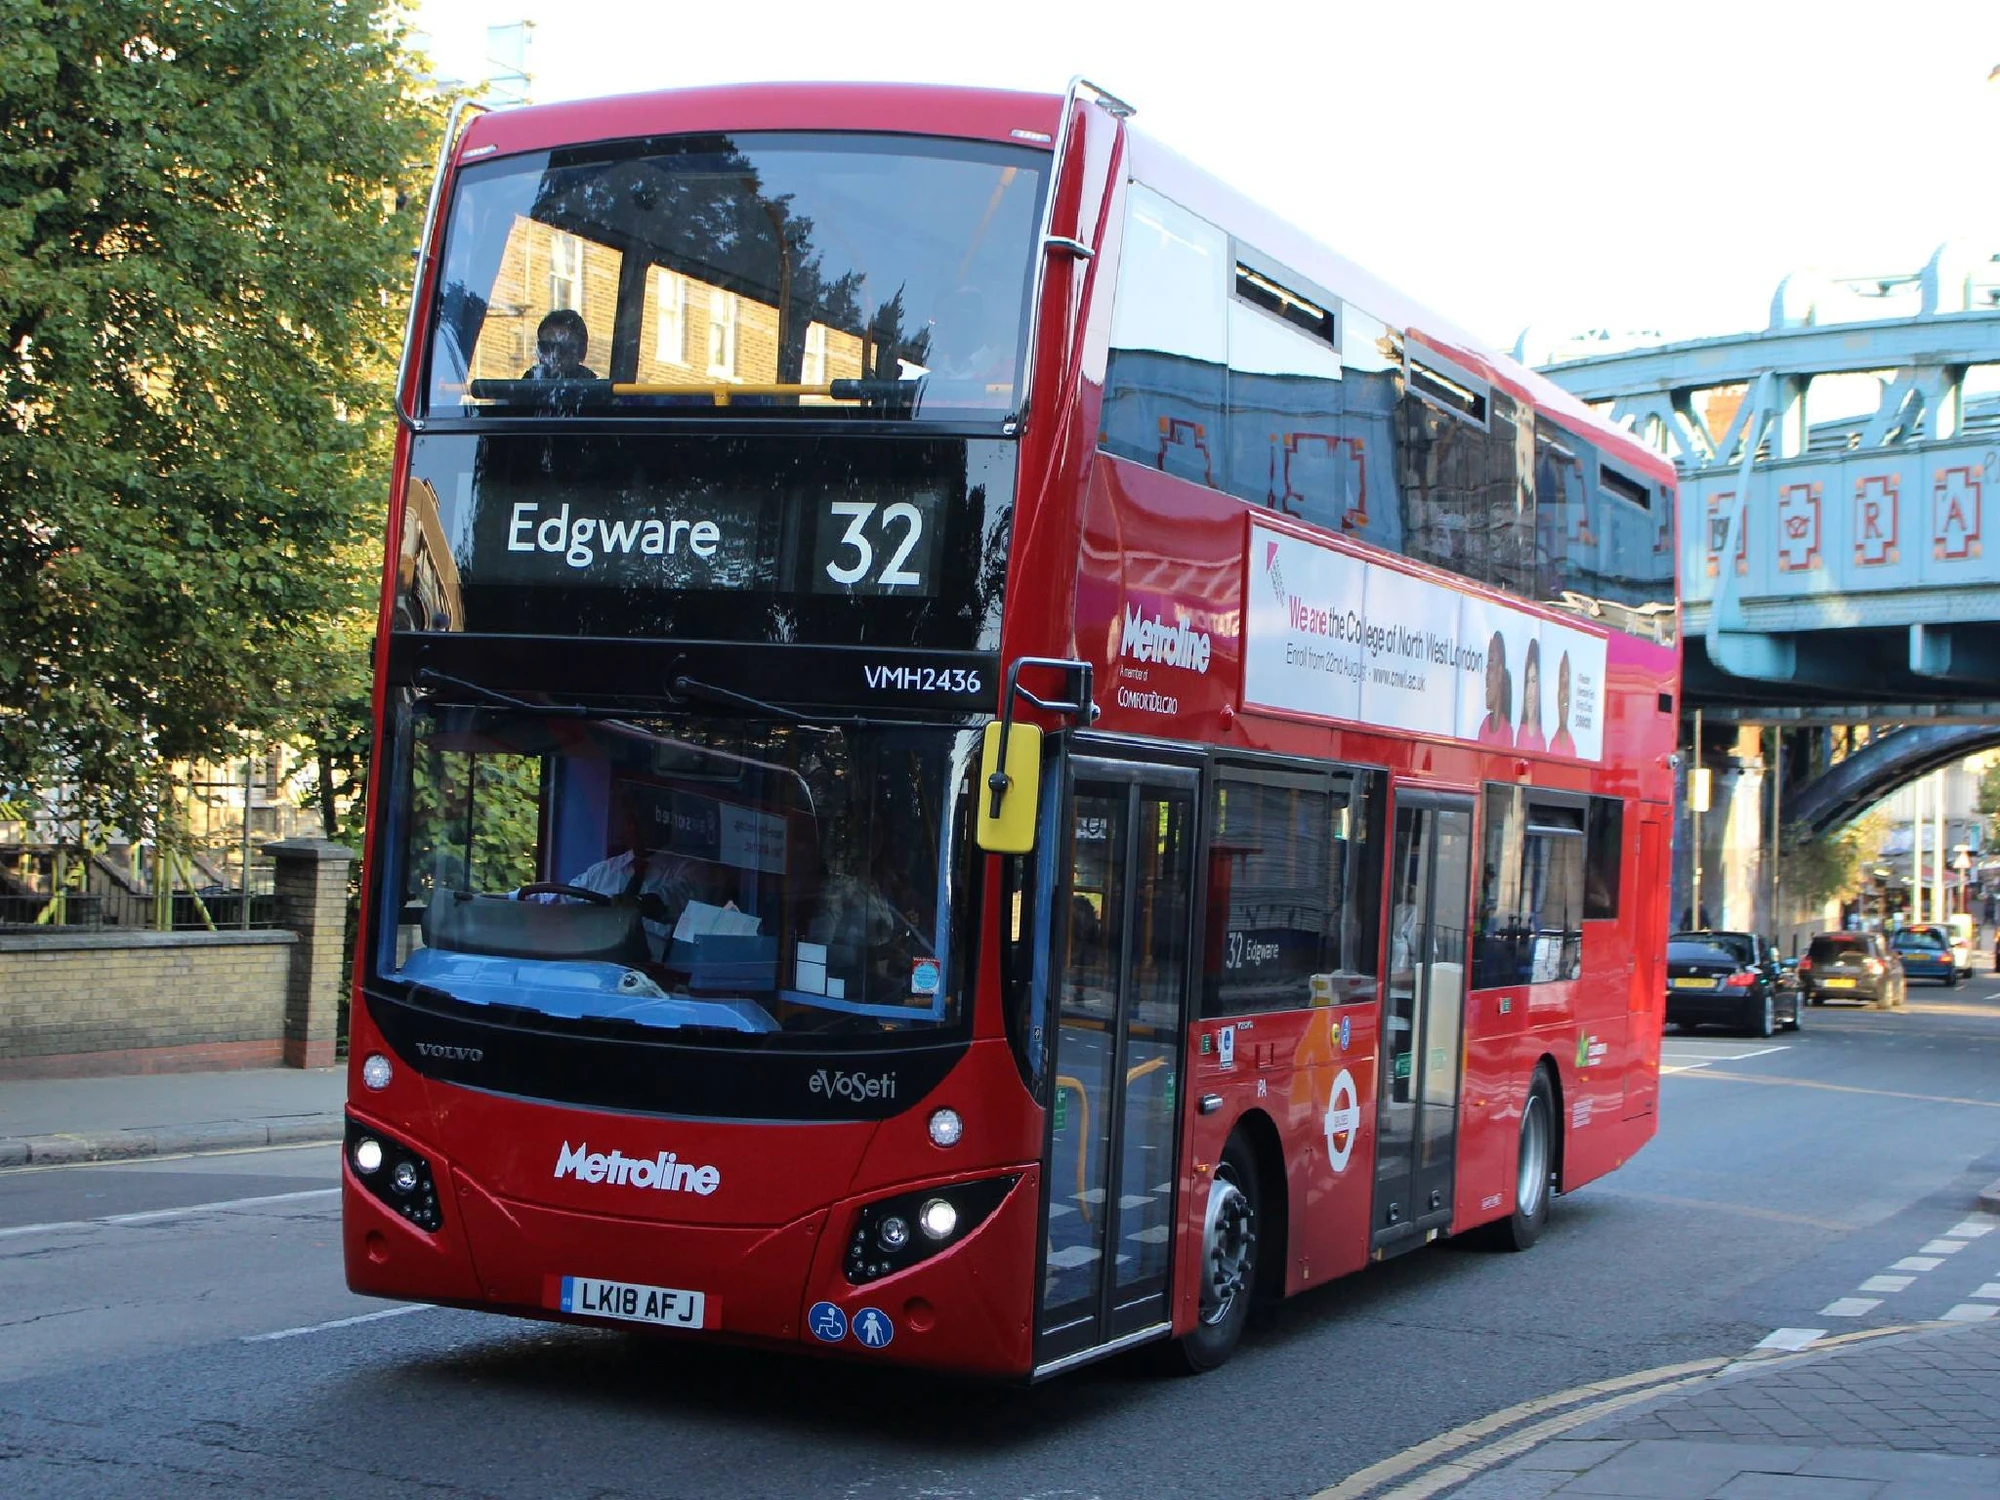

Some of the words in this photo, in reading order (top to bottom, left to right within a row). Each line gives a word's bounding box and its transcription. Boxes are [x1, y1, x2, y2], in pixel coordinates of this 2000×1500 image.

[507, 502, 720, 567] Edgware
[826, 501, 923, 585] 32
[1121, 601, 1211, 674] Metroline
[1289, 595, 1308, 631] We
[1309, 605, 1327, 635] are
[1328, 608, 1344, 639] the
[1347, 610, 1385, 657] College
[1385, 624, 1397, 653] of
[1398, 626, 1424, 659] North
[1426, 632, 1448, 664] West
[1449, 638, 1483, 672] London
[1287, 642, 1308, 668] Enroll
[1308, 646, 1325, 670] from
[1326, 651, 1343, 674] 22nd
[864, 665, 981, 693] VMH2436
[1226, 932, 1242, 968] 32
[1246, 939, 1279, 966] Edgware
[415, 1042, 484, 1062] VOLVO
[809, 1068, 897, 1102] eVoSeti
[553, 1140, 721, 1196] Metroline
[582, 1283, 638, 1314] LK18
[645, 1291, 693, 1322] AFJ
